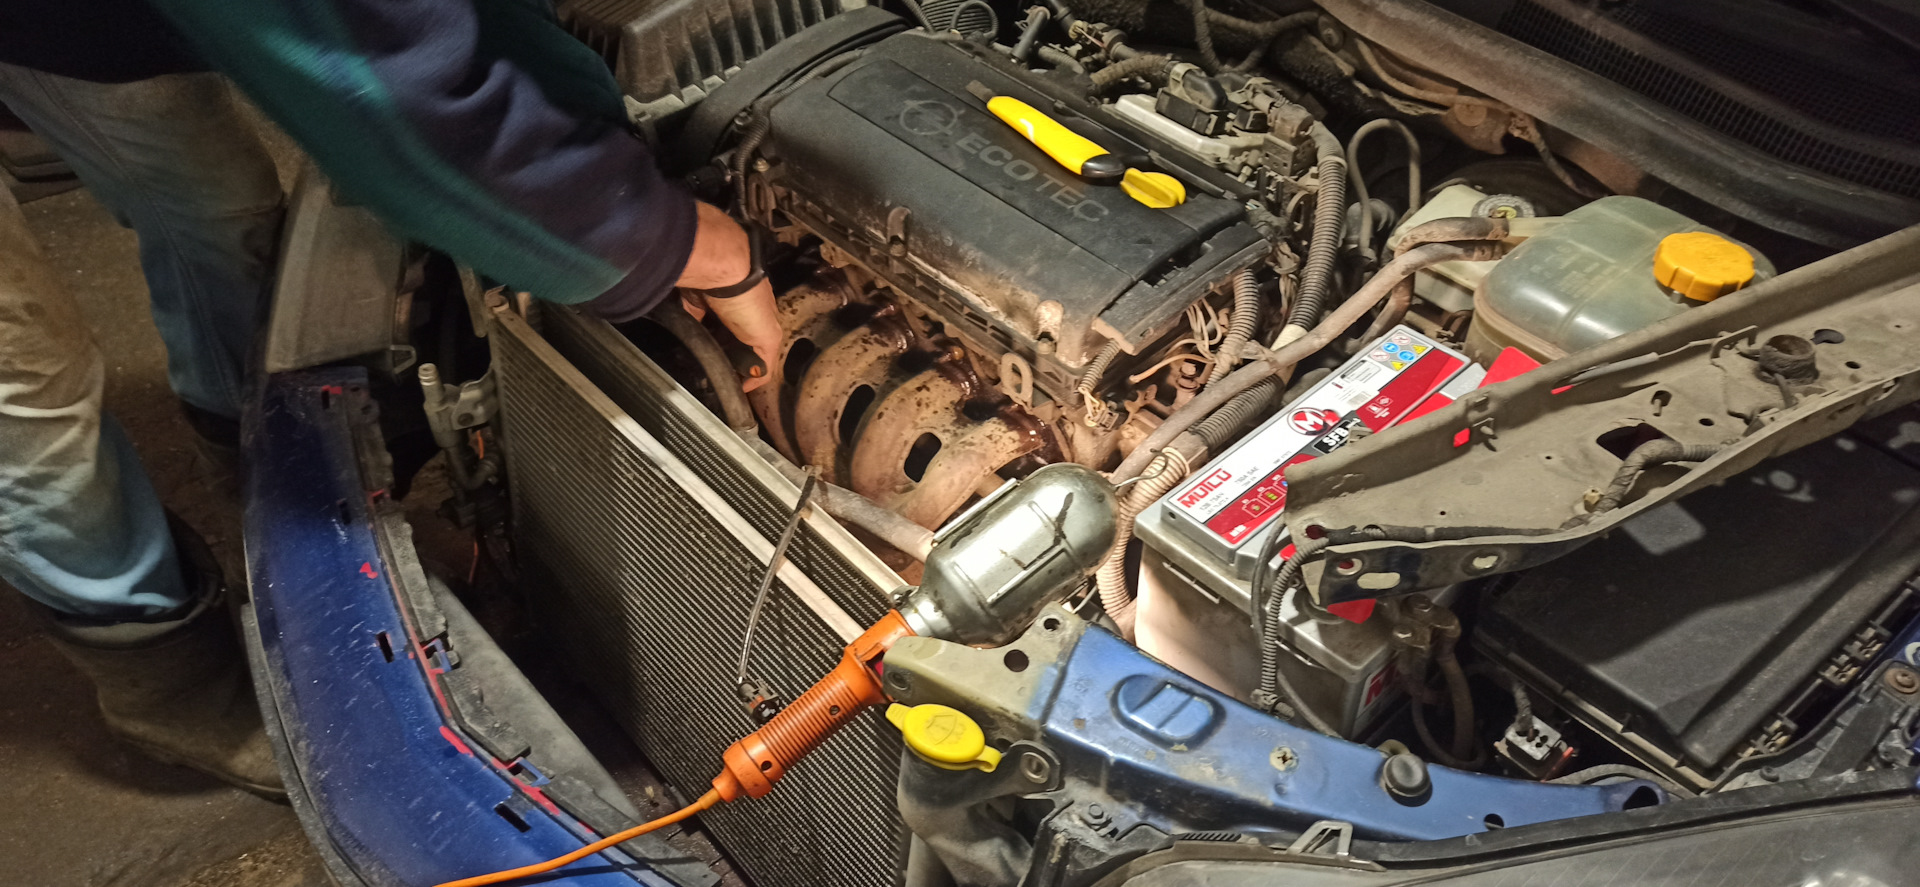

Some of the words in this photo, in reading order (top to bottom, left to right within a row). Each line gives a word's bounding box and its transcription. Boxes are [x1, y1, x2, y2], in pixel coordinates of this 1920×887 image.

[955, 132, 1110, 223] ECOTEC
[1321, 427, 1349, 447] SFB
[1177, 468, 1232, 508] MUTLU
